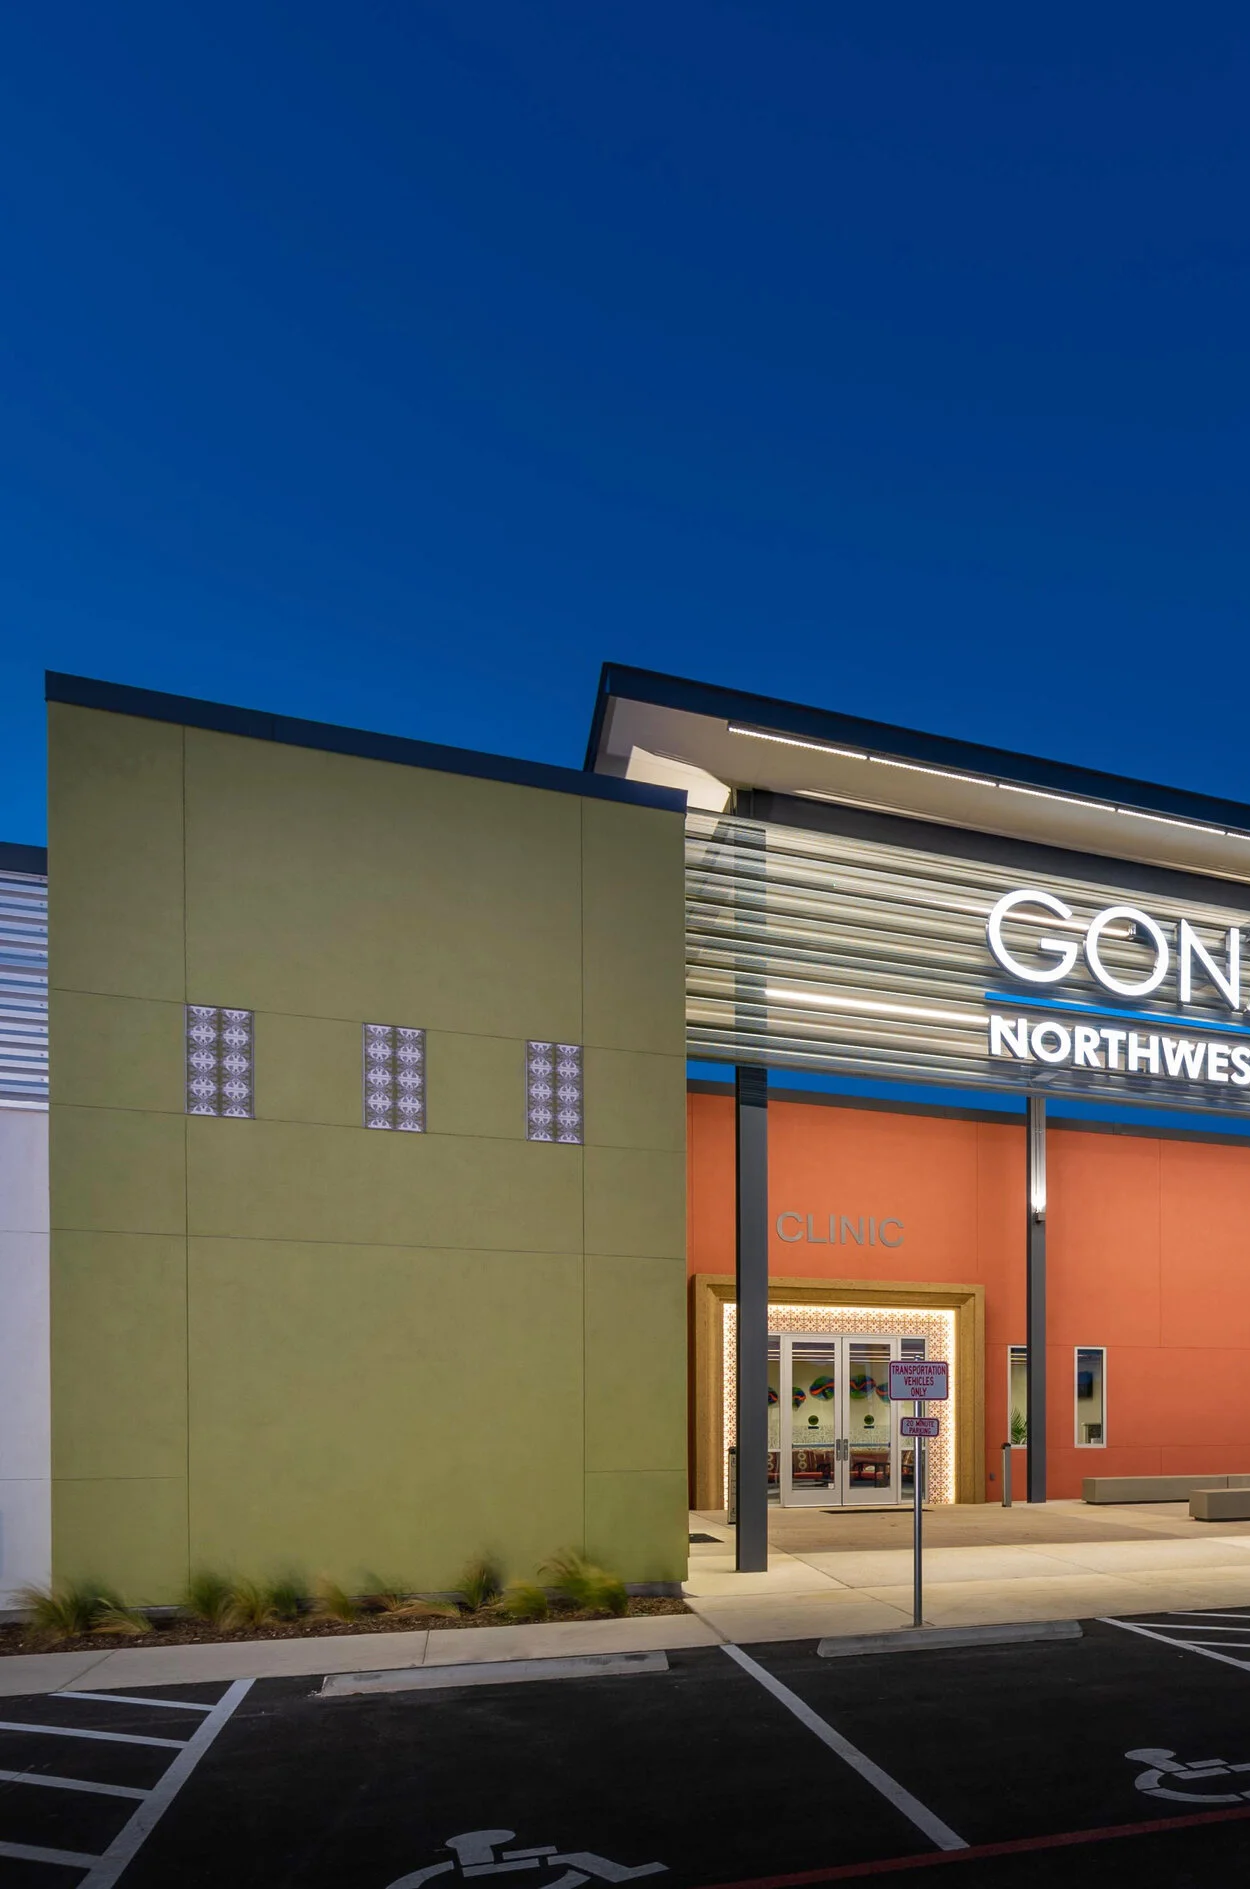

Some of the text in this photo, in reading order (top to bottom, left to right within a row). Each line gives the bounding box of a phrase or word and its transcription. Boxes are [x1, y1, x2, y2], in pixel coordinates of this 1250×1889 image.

[776, 1211, 905, 1247] CLINIC
[891, 1365, 946, 1375] TRANSPORTATION
[904, 1376, 934, 1386] VEHICLES
[910, 1387, 927, 1397] ONLY
[915, 1420, 934, 1428] MINUTE
